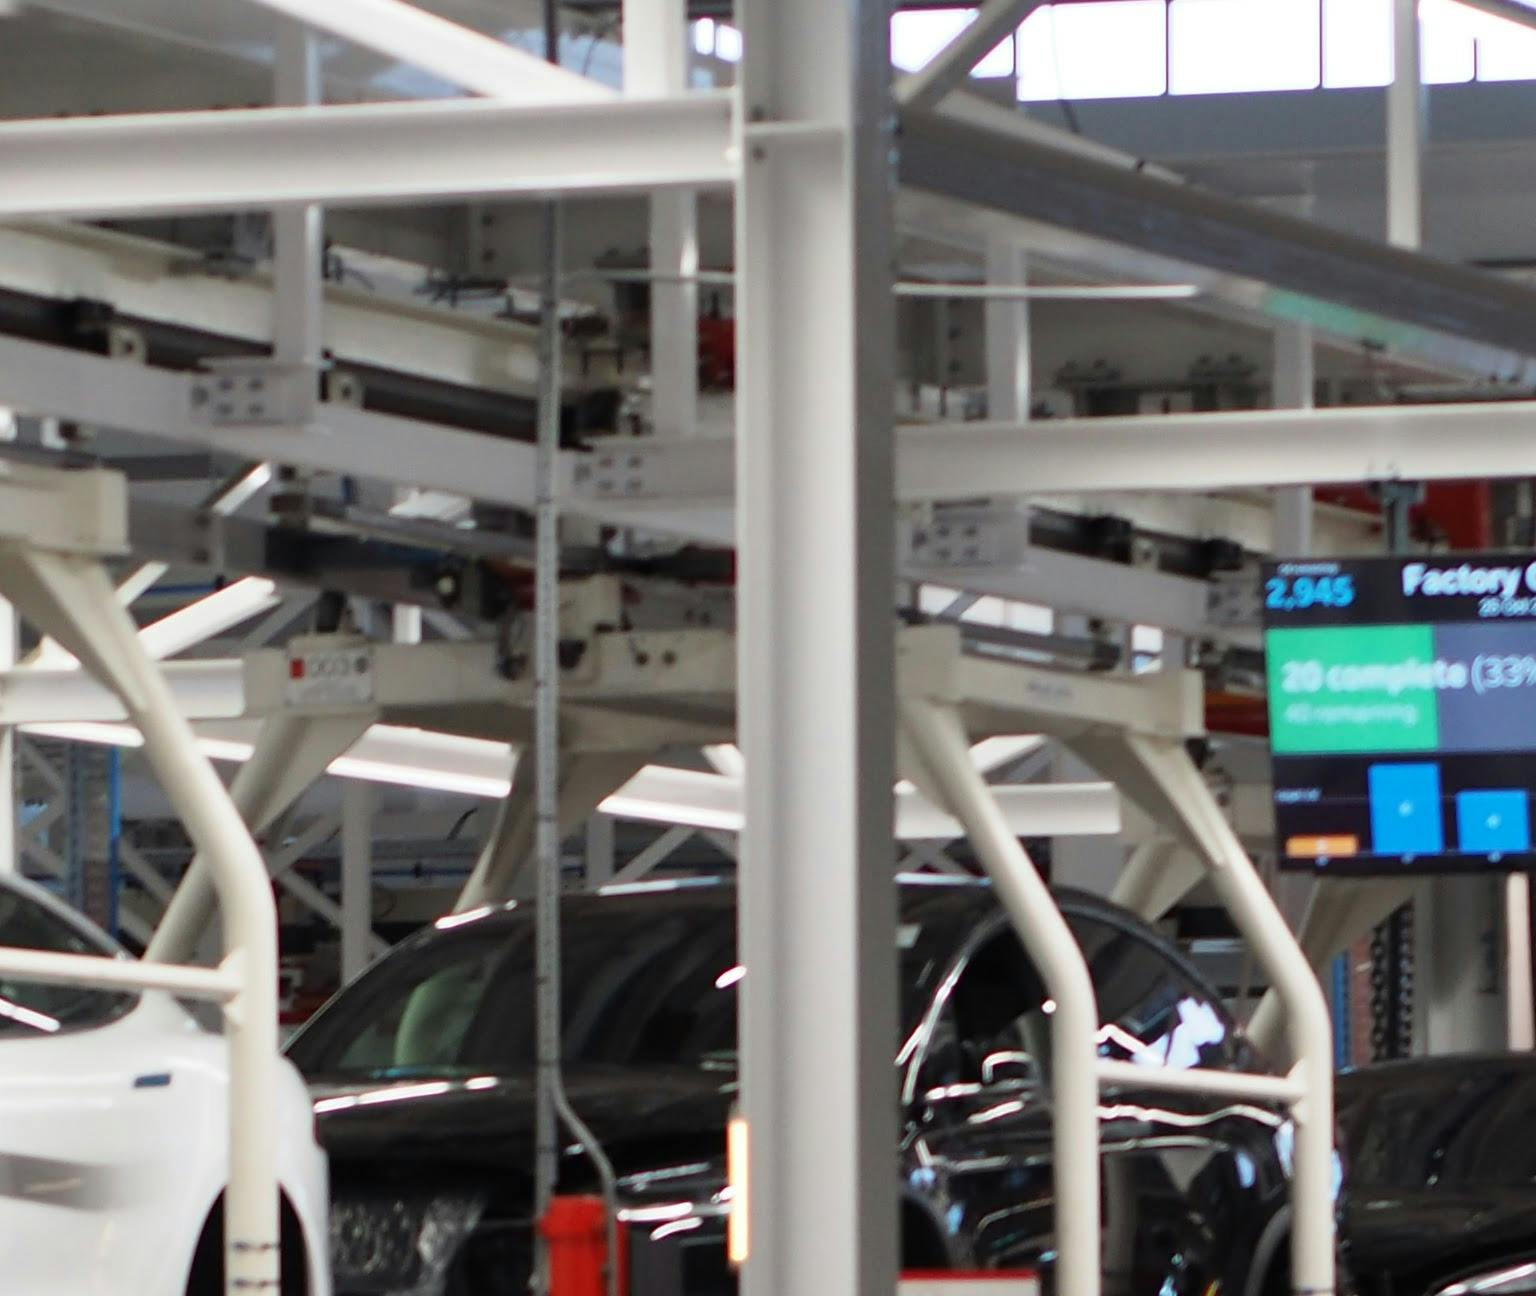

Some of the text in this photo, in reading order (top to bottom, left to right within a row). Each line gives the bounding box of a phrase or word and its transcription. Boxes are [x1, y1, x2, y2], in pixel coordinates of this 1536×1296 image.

[1265, 576, 1355, 611] 2,945
[1402, 563, 1521, 601] Factory
[1325, 657, 1467, 696] complete
